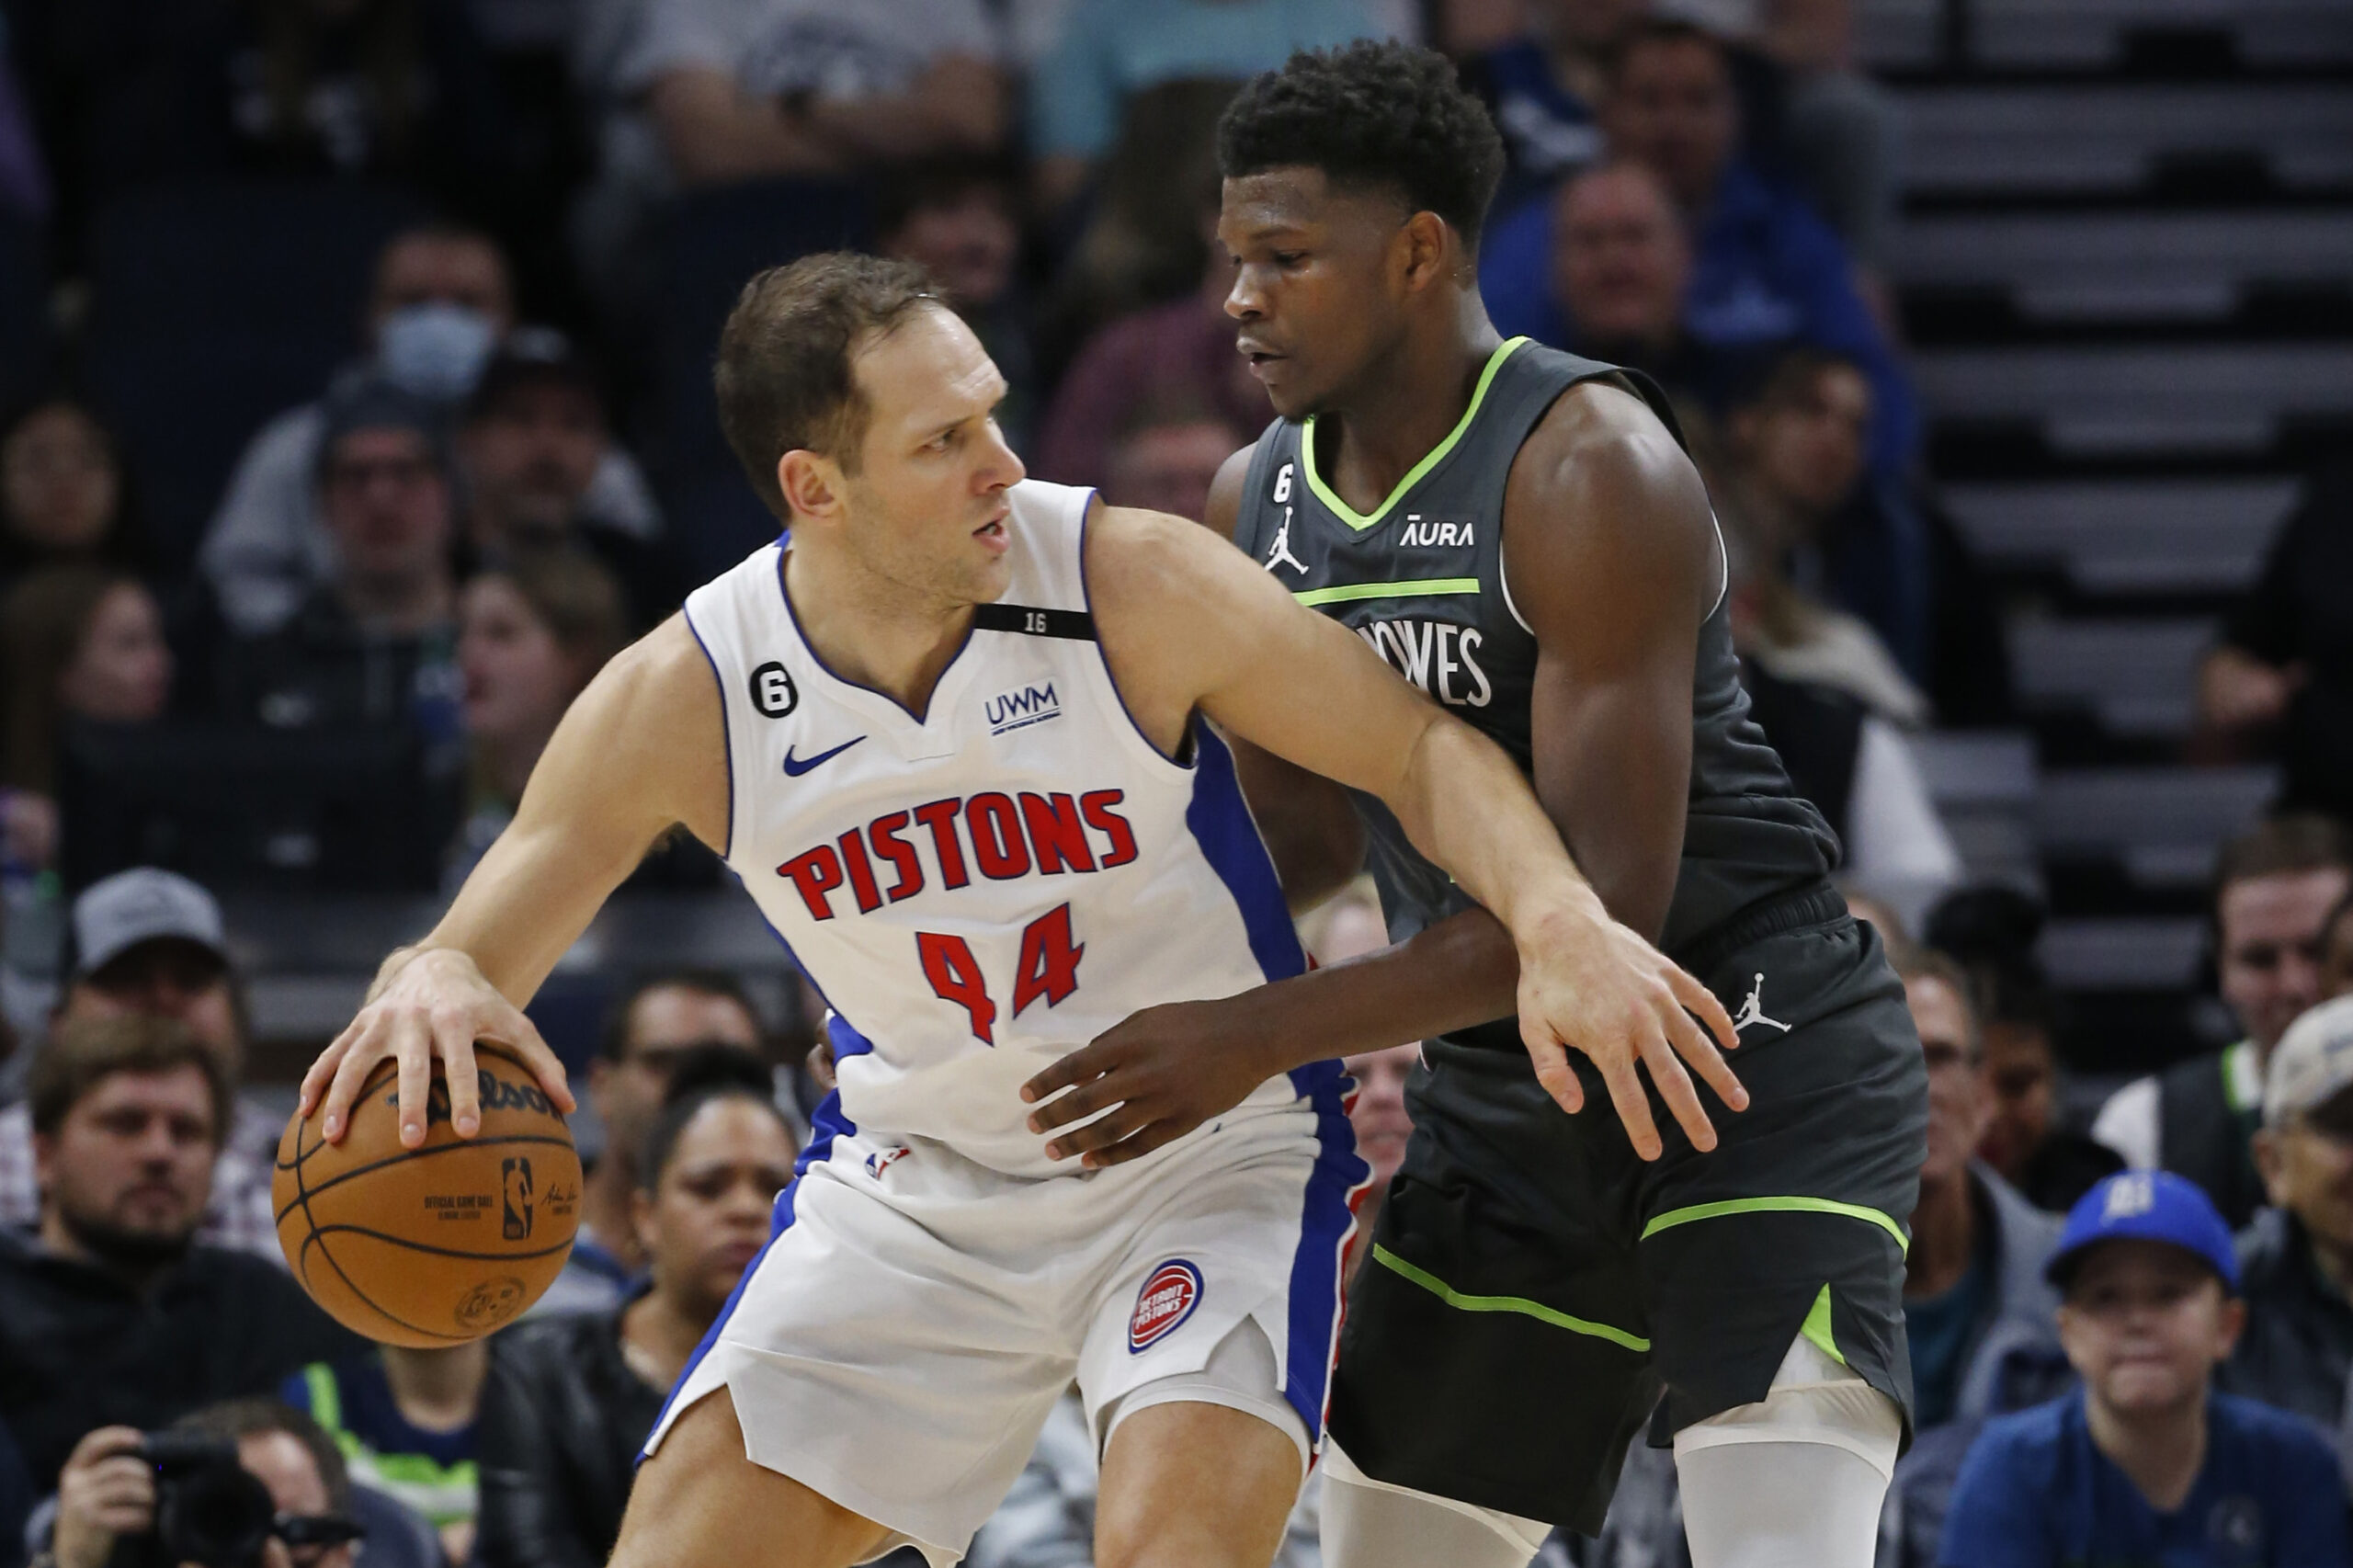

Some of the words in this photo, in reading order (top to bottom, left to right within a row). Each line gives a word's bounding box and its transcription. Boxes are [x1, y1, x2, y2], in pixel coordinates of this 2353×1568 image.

[1272, 462, 1294, 504] 6
[1024, 611, 1047, 633] 16
[758, 669, 792, 713] 6
[984, 681, 1059, 725] UWM
[777, 789, 1139, 921] PISTONS
[915, 902, 1086, 1048] 44
